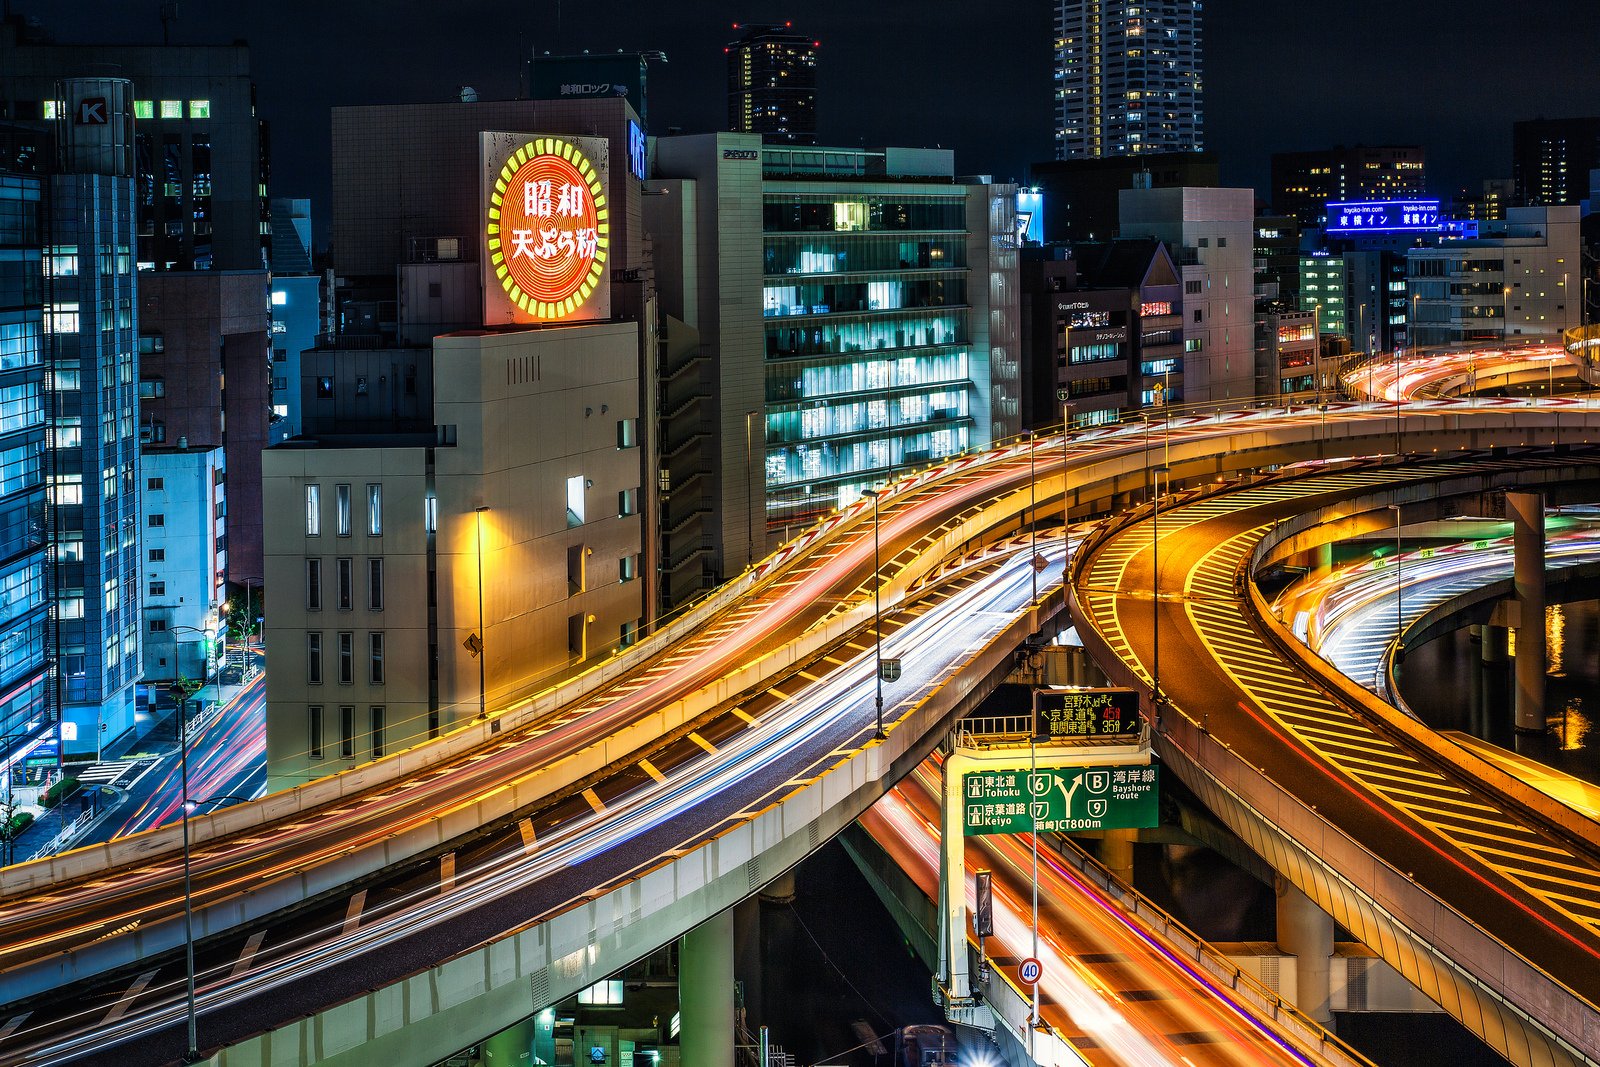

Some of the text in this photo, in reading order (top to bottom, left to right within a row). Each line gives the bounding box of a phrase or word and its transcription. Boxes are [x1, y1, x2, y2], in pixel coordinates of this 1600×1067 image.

[560, 83, 610, 95] 美和ロック
[82, 103, 105, 123] K
[524, 180, 583, 217] 昭和
[1343, 207, 1384, 215] toyoko-inn.com
[1403, 205, 1437, 213] toyoko-inn.com
[1340, 214, 1388, 226] 東横イン
[1403, 213, 1438, 225] 東横イン
[511, 227, 598, 259] 天ぷら粉
[1103, 707, 1120, 720] 45分
[1102, 720, 1120, 733] 35分
[985, 775, 1015, 788] 東北道
[1092, 775, 1103, 789] B
[1112, 769, 1155, 783] 湾岸線
[1035, 777, 1044, 791] 6
[1112, 784, 1151, 793] Bayshore
[985, 788, 1020, 797] Tohoku
[1113, 792, 1139, 800] -route
[985, 803, 1026, 816] 京葉道路
[1036, 805, 1043, 816] 7
[1093, 802, 1101, 814] 9
[985, 817, 1012, 827] Keiyo
[1024, 964, 1038, 978] 40
